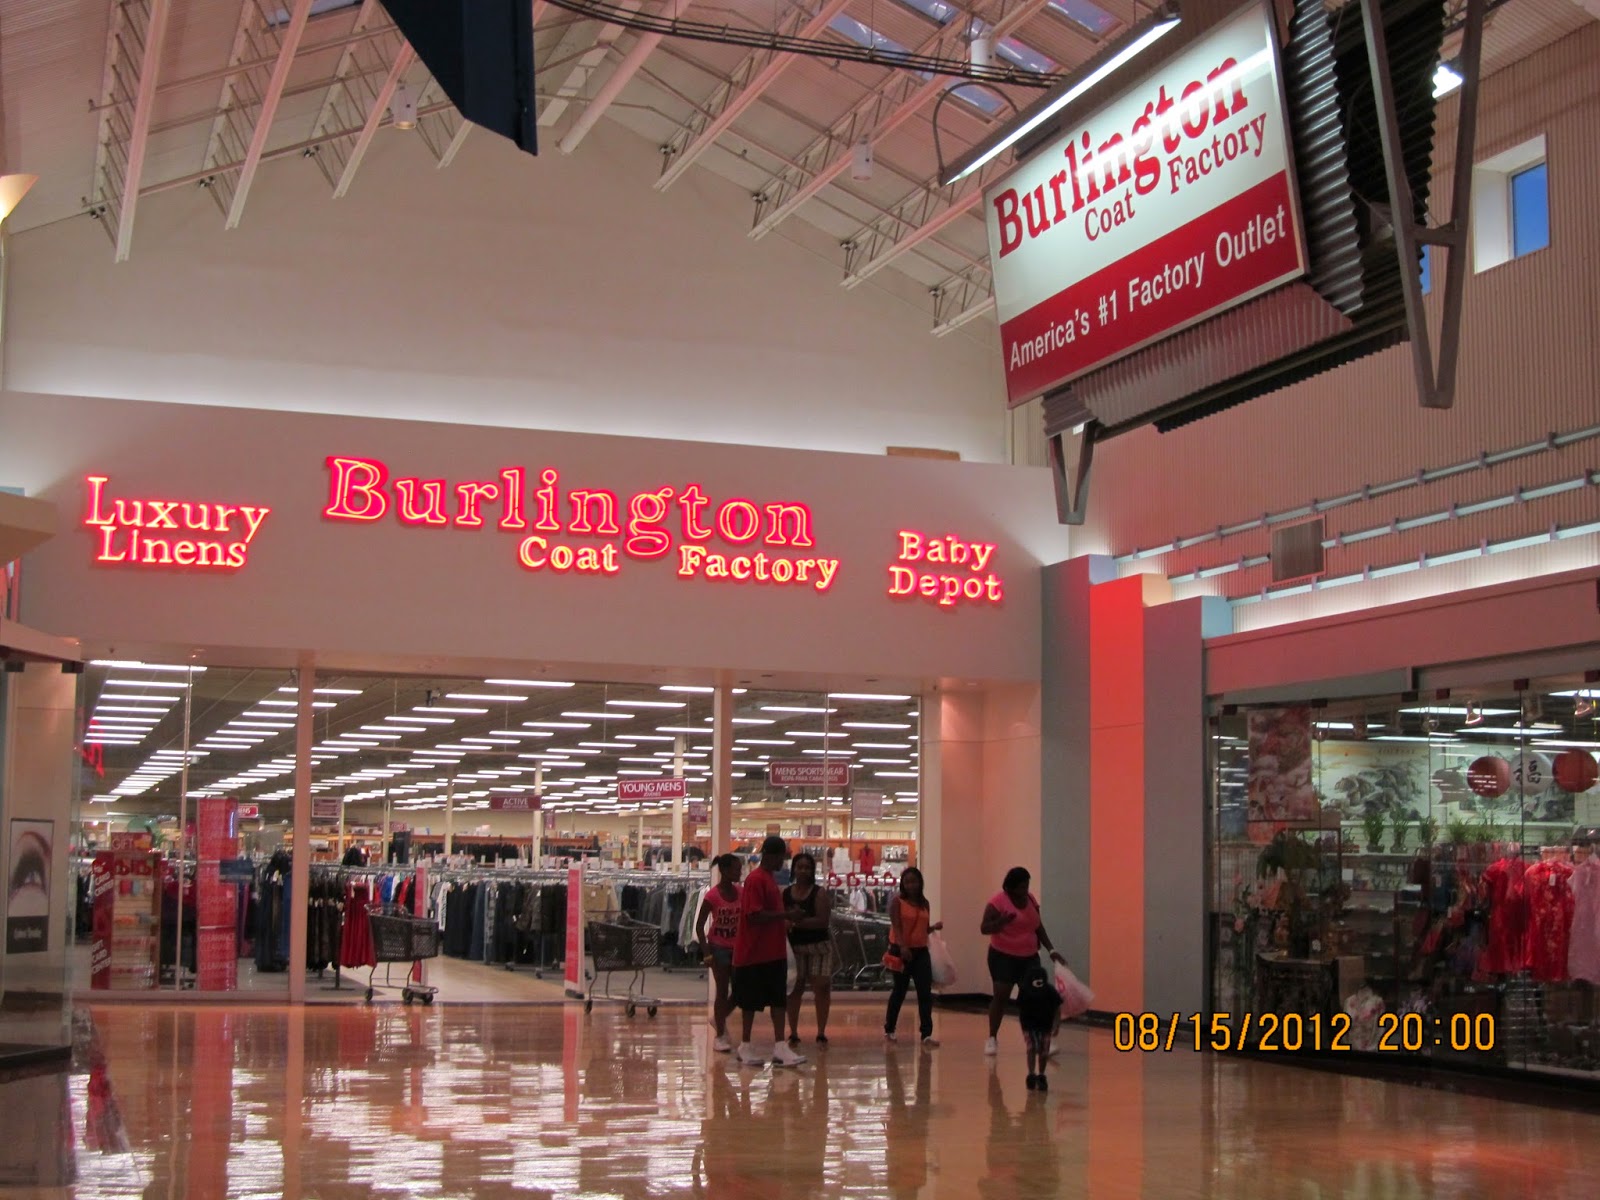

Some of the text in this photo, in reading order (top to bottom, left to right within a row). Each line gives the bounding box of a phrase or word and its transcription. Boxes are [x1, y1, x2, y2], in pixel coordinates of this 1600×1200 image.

[993, 57, 1248, 259] Burlington
[1085, 112, 1268, 242] Coat Factory
[1010, 204, 1287, 372] America's #1 Factory Outlet
[85, 475, 270, 543] Luxury
[325, 455, 814, 558] Burlington
[98, 524, 248, 568] Linens
[518, 534, 840, 590] Coat Factory
[898, 529, 996, 571] Baby
[888, 565, 1004, 605] Depot
[622, 781, 682, 793] YOUNG MENS
[775, 767, 797, 776] MENS
[503, 797, 528, 805] ACTIVE
